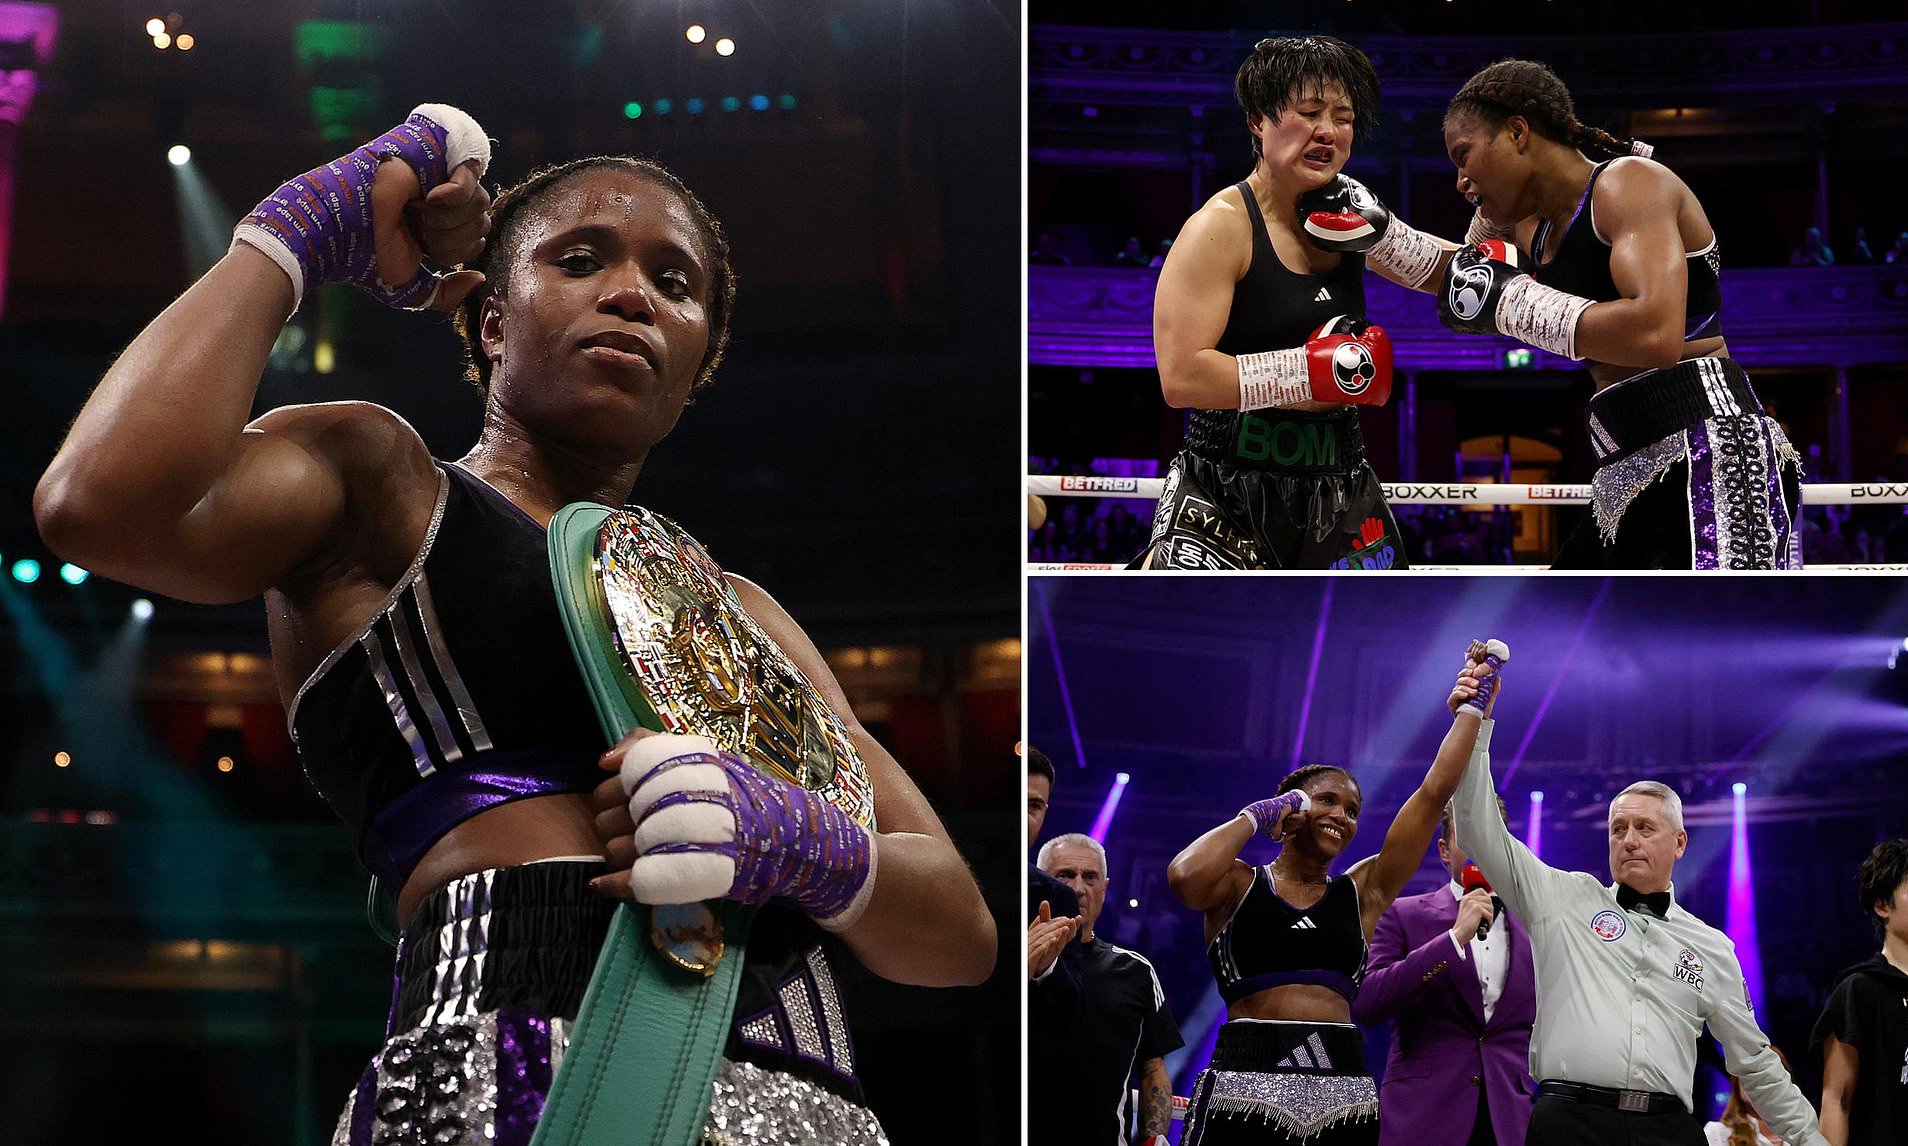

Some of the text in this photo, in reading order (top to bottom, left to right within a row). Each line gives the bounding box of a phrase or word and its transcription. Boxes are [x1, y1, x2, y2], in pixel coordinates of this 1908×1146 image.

[275, 206, 294, 222] tape
[291, 219, 309, 238] gym
[1236, 414, 1337, 465] BOM
[1063, 477, 1135, 492] BETFRED
[1675, 965, 1704, 990] WBC
